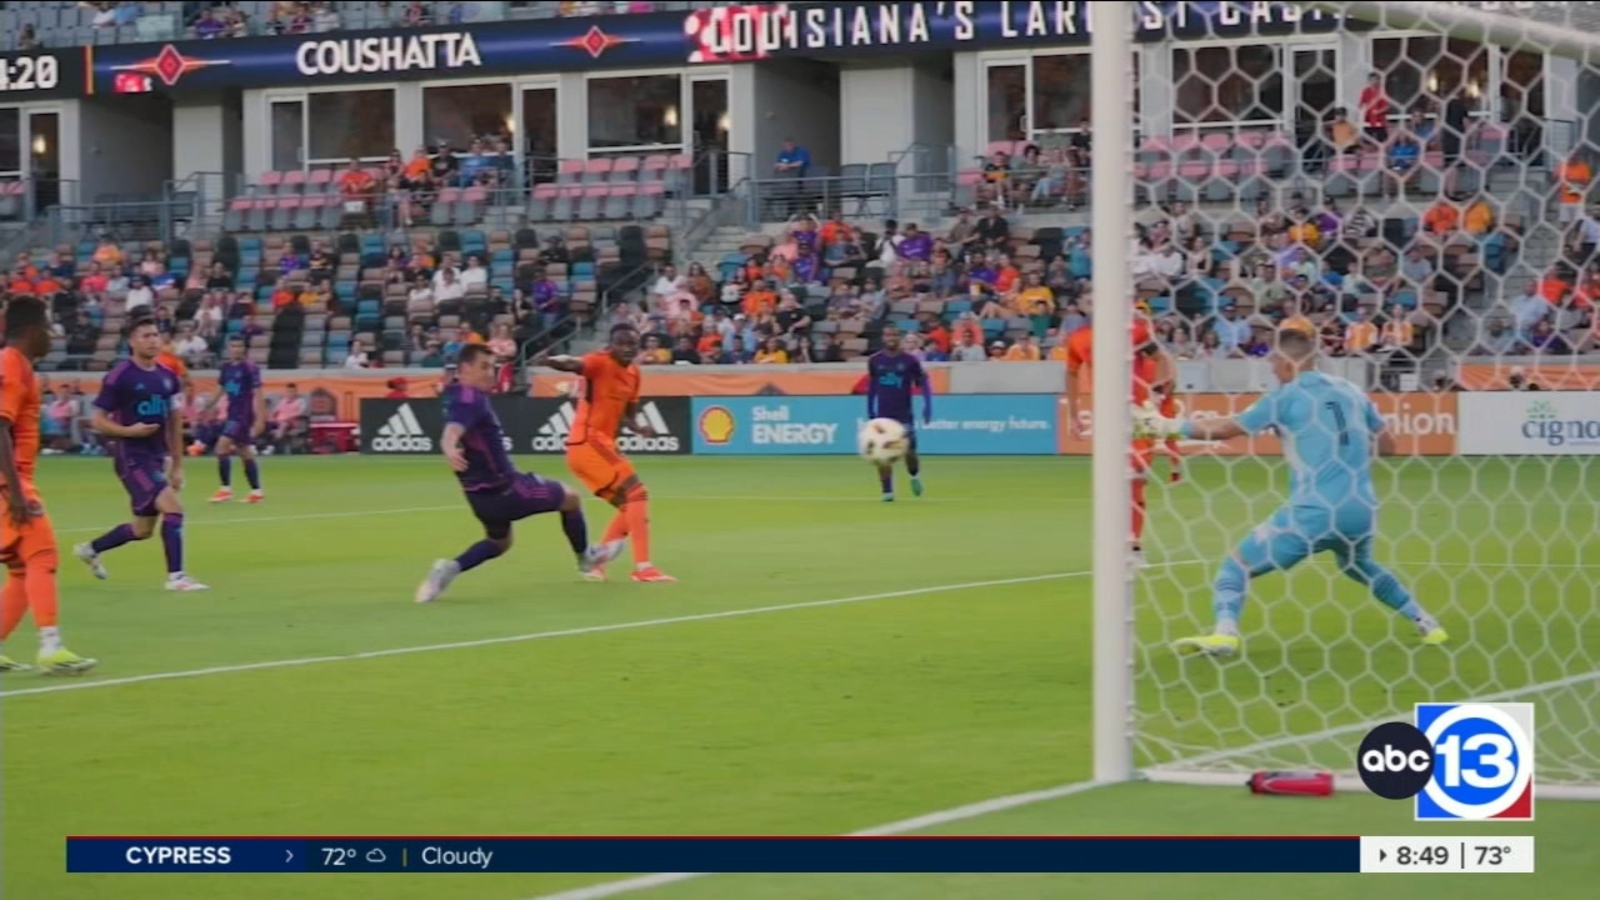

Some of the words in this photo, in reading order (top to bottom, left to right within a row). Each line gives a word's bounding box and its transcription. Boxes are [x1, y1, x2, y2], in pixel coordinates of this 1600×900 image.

[711, 3, 975, 53] LOUISIANA'S
[297, 32, 480, 75] COUSHATTA
[752, 406, 789, 421] Shell
[1325, 401, 1350, 446] 1
[1376, 402, 1456, 435] nion
[752, 423, 838, 444] ENERGY
[962, 419, 1005, 433] energy
[372, 434, 432, 451] adidas
[615, 434, 679, 451] adidas
